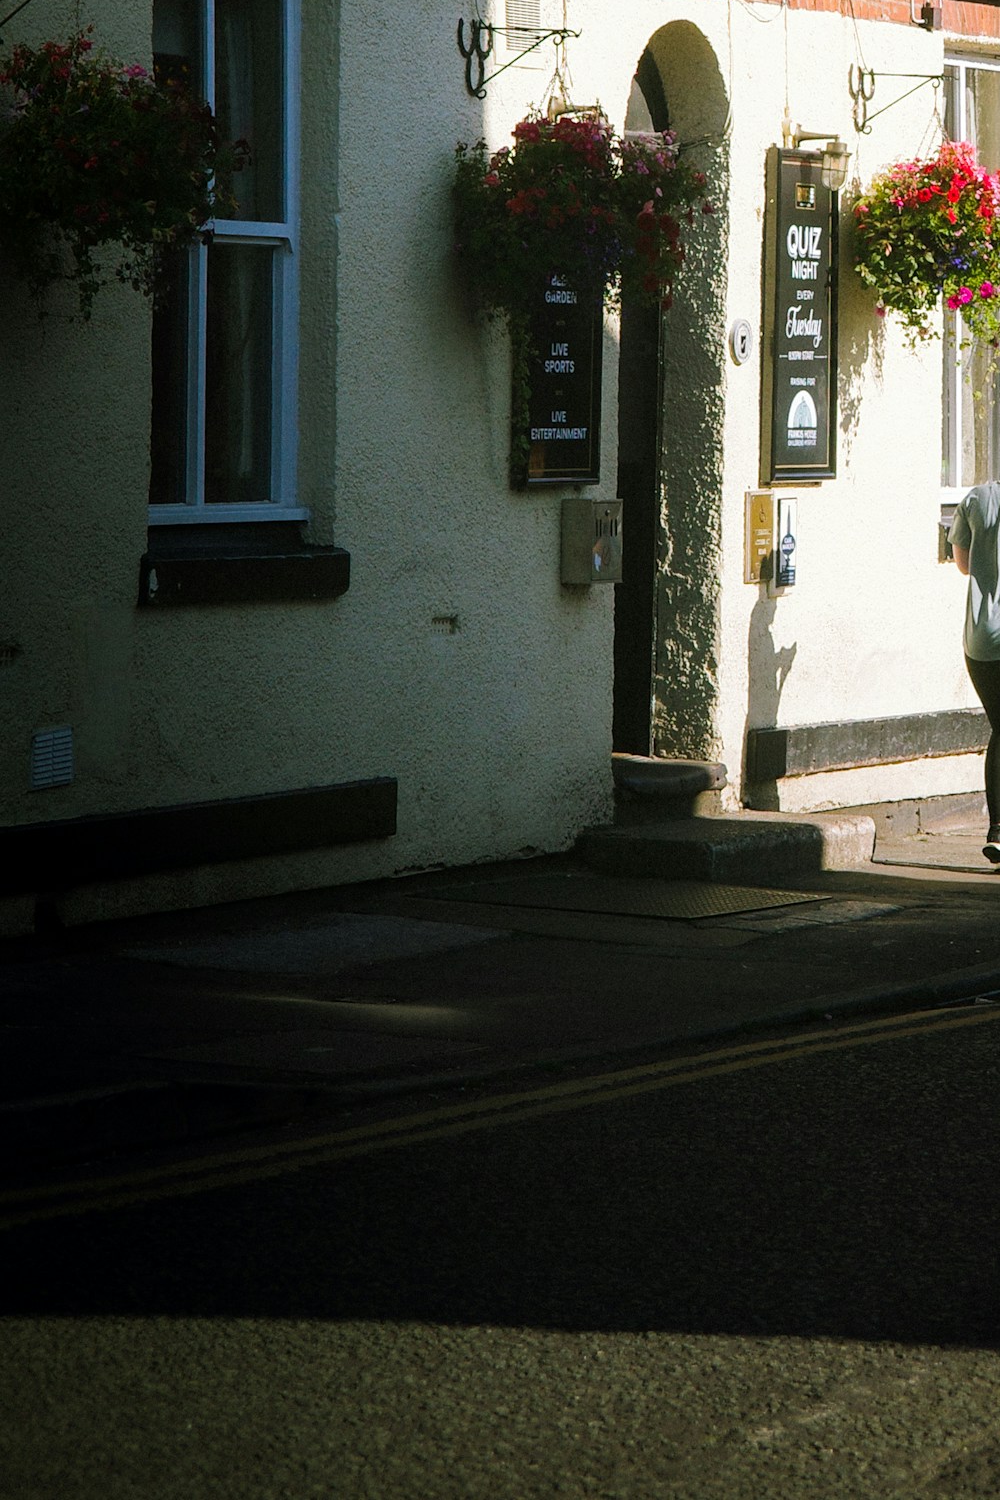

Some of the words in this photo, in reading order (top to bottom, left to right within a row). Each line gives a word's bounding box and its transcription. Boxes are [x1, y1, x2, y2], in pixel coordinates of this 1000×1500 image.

[787, 224, 822, 260] QUIZ
[791, 260, 819, 280] NIGHT
[545, 290, 578, 304] GARDEN
[796, 290, 815, 301] EVERY
[785, 305, 823, 348] Tuesday
[551, 342, 569, 356] LIVE
[544, 360, 575, 373] SPORTS
[551, 410, 567, 423] LIVE
[531, 427, 588, 441] ENTERTAINMENT
